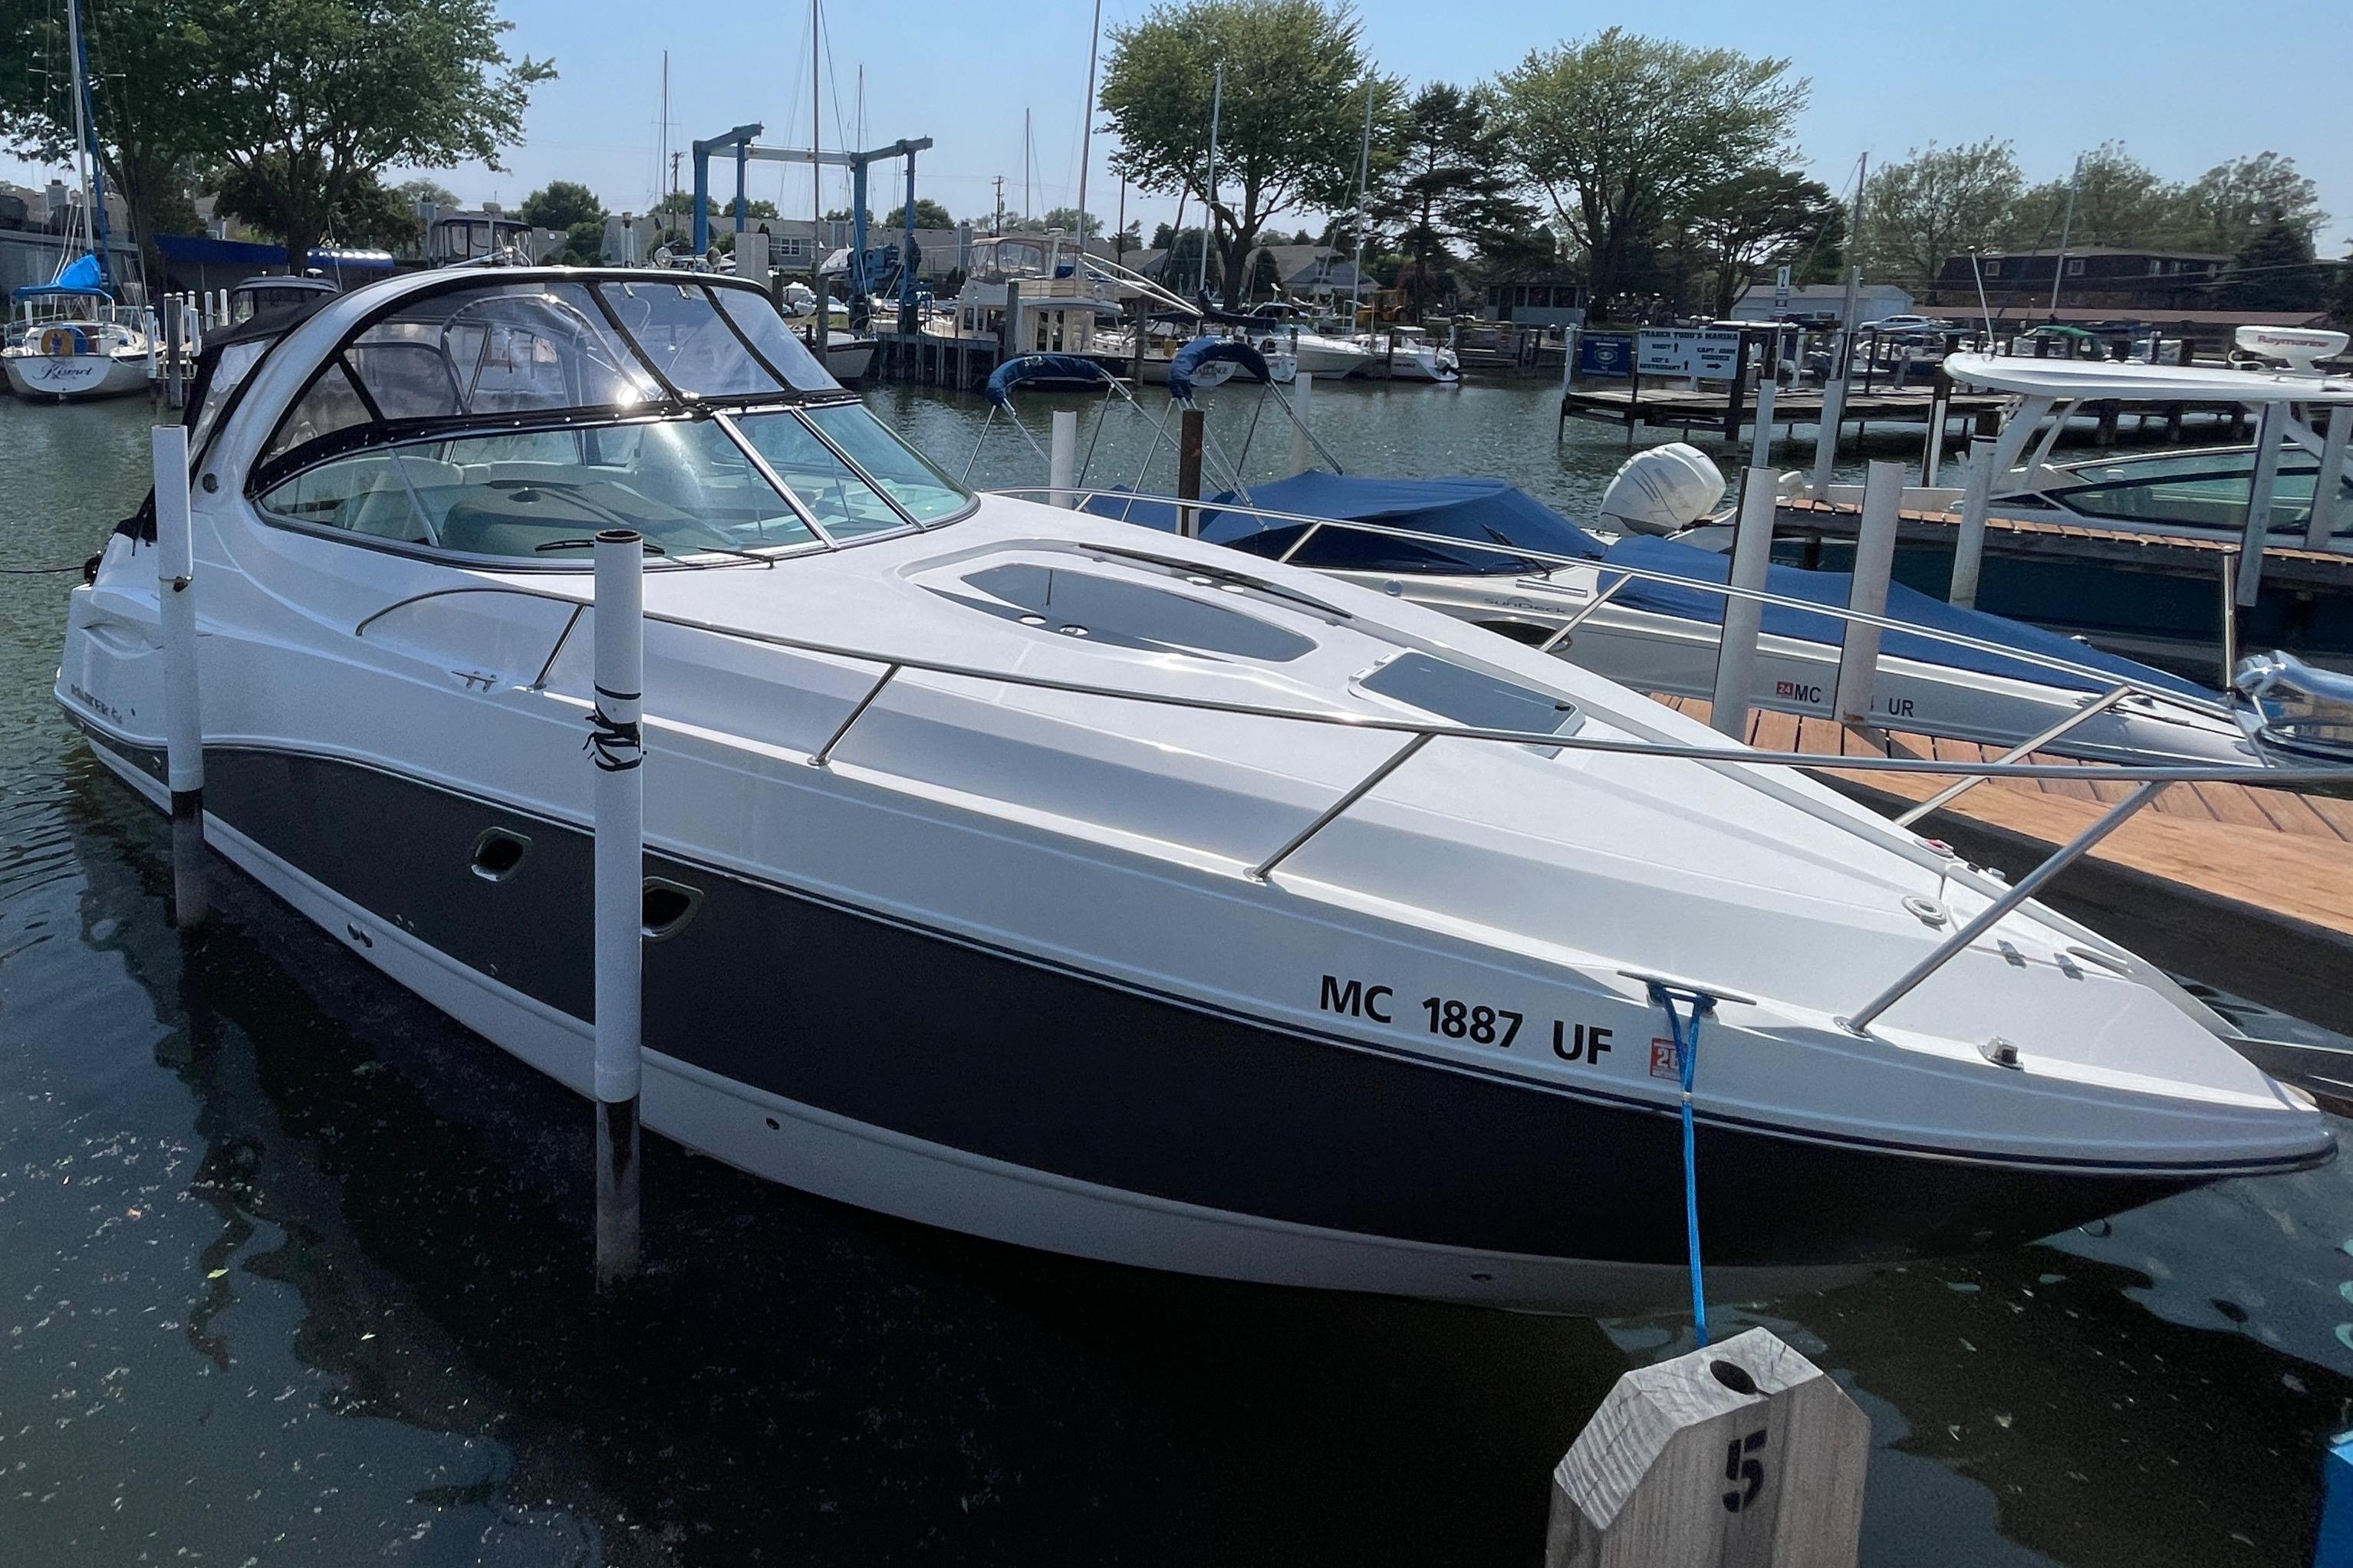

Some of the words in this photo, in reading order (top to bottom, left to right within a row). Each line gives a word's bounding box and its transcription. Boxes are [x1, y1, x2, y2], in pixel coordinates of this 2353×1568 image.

[2257, 335, 2329, 347] Raymarine
[1778, 685, 1791, 694] 24
[1794, 684, 1822, 704] MC
[1888, 698, 1914, 718] UR
[1320, 975, 1394, 1024] MC
[1422, 998, 1523, 1048] 1887
[1552, 1020, 1613, 1065] UF
[1722, 1429, 1767, 1513] 5
